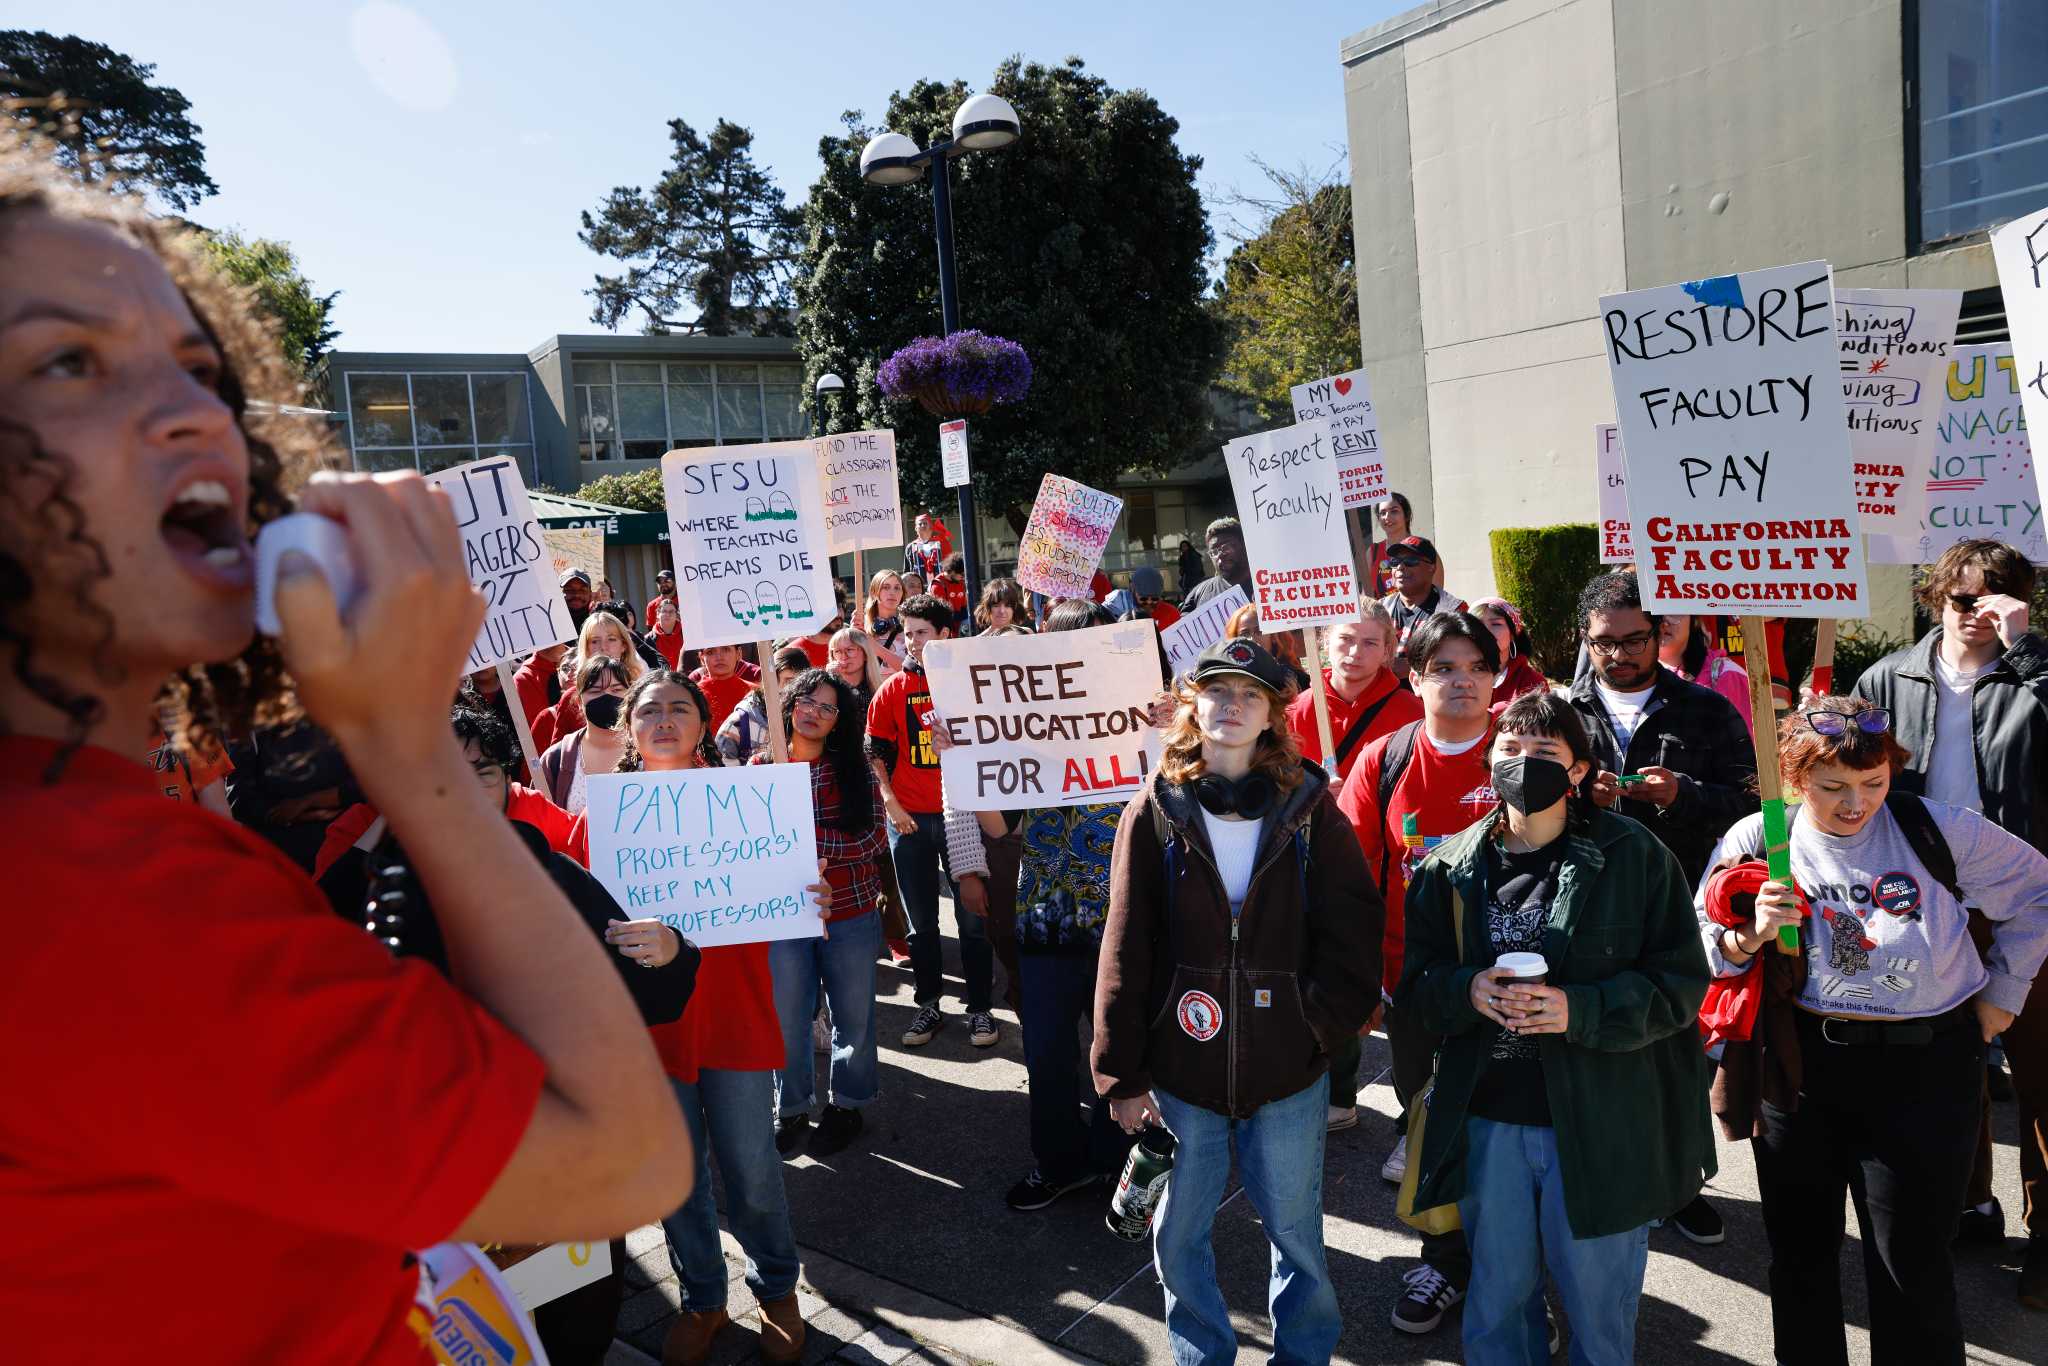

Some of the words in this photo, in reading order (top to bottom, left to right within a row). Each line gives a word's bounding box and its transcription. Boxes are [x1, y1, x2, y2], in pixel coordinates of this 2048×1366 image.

[1605, 275, 1830, 364] RESTORE
[1947, 355, 2020, 401] UT
[1309, 383, 1330, 402] MY
[1639, 375, 1813, 429] FACULTY
[1298, 408, 1326, 421] FOR
[1343, 415, 1363, 429] PAY
[815, 439, 845, 457] FUND
[850, 435, 878, 450] THE
[1331, 429, 1377, 455] RENT
[825, 459, 892, 476] CLASSROOM
[1241, 433, 1328, 479] Respect
[684, 458, 778, 494] SFSU
[1338, 464, 1383, 479] FORNIA
[1341, 474, 1383, 491] ULTY
[1680, 451, 1770, 502] PAY
[825, 486, 847, 503] NOT
[853, 484, 880, 498] THE
[1046, 480, 1120, 520] FACULTY
[1252, 482, 1332, 531] Faculty
[1344, 488, 1387, 503] CIATION
[675, 515, 739, 532] WHERE
[826, 508, 896, 530] BOARDROOM
[1051, 511, 1109, 545] SUPPORT
[1646, 517, 1851, 543] CALIFORNIA
[1921, 500, 2041, 535] CULTY
[703, 529, 798, 551] TEACHING
[1026, 524, 1045, 540] IS
[466, 521, 541, 577] AGERS
[1034, 542, 1089, 569] STUDENT
[1650, 545, 1852, 571] FACULTY
[684, 556, 762, 582] DREAMS
[779, 552, 813, 571] DIE
[1039, 563, 1088, 588] SUPPORT
[1255, 564, 1351, 585] CALIFORNIA
[1259, 581, 1352, 603] FACULTY
[1654, 574, 1857, 601] ASSOCIATION
[1261, 603, 1356, 621] ASSOCIATION
[969, 661, 1087, 704] FREE
[946, 702, 1155, 746] EDUCATION
[977, 758, 1045, 797] FOR
[1062, 750, 1148, 793] ALL!
[614, 782, 687, 835] PAY
[705, 782, 777, 837] MY
[616, 828, 799, 879] PROFESSORS!
[626, 880, 680, 908] KEEP
[694, 874, 734, 898] MY
[1846, 1001, 1862, 1010] this
[1864, 1003, 1896, 1014] feeling
